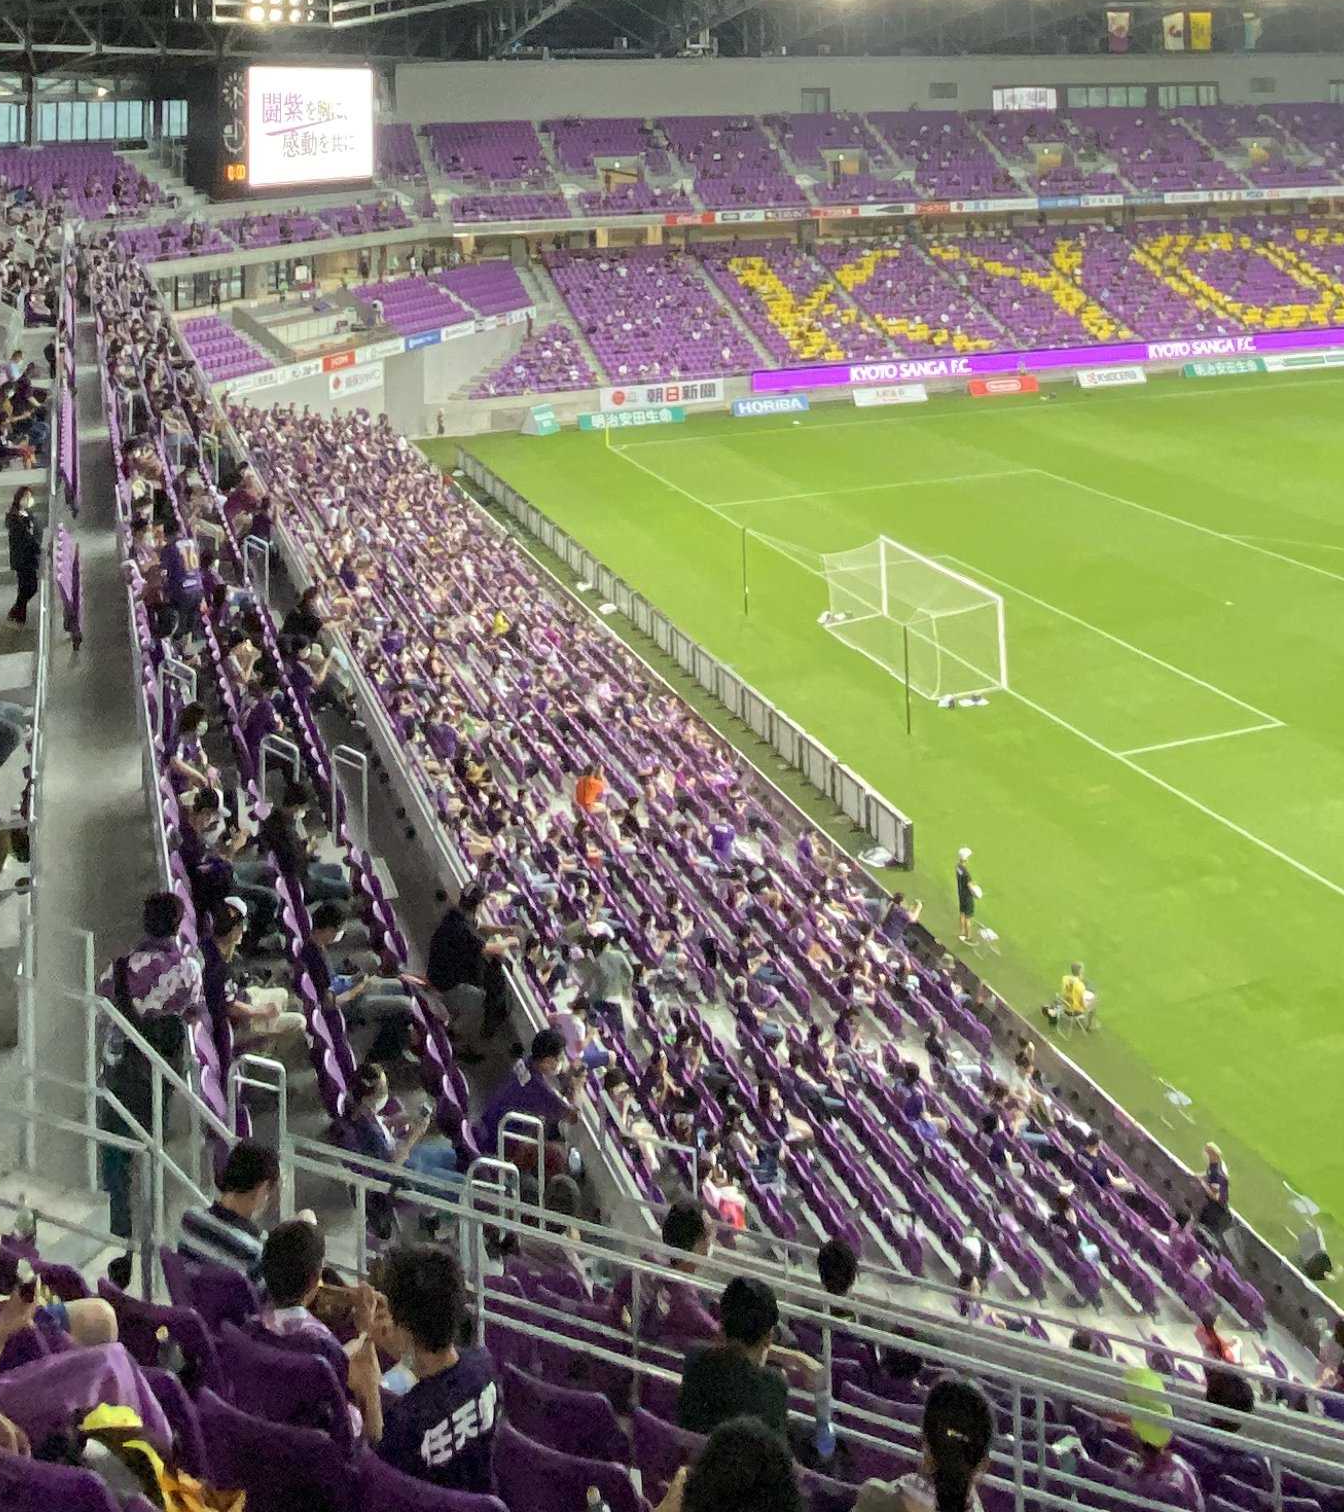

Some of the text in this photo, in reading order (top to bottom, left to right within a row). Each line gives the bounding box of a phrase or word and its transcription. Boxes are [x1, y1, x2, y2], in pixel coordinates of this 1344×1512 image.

[1148, 342, 1191, 359] KYOTO
[1191, 338, 1236, 355] SANGA
[850, 364, 898, 382] KYOTO
[898, 360, 949, 377] SANGA
[738, 396, 804, 415] HORIBA
